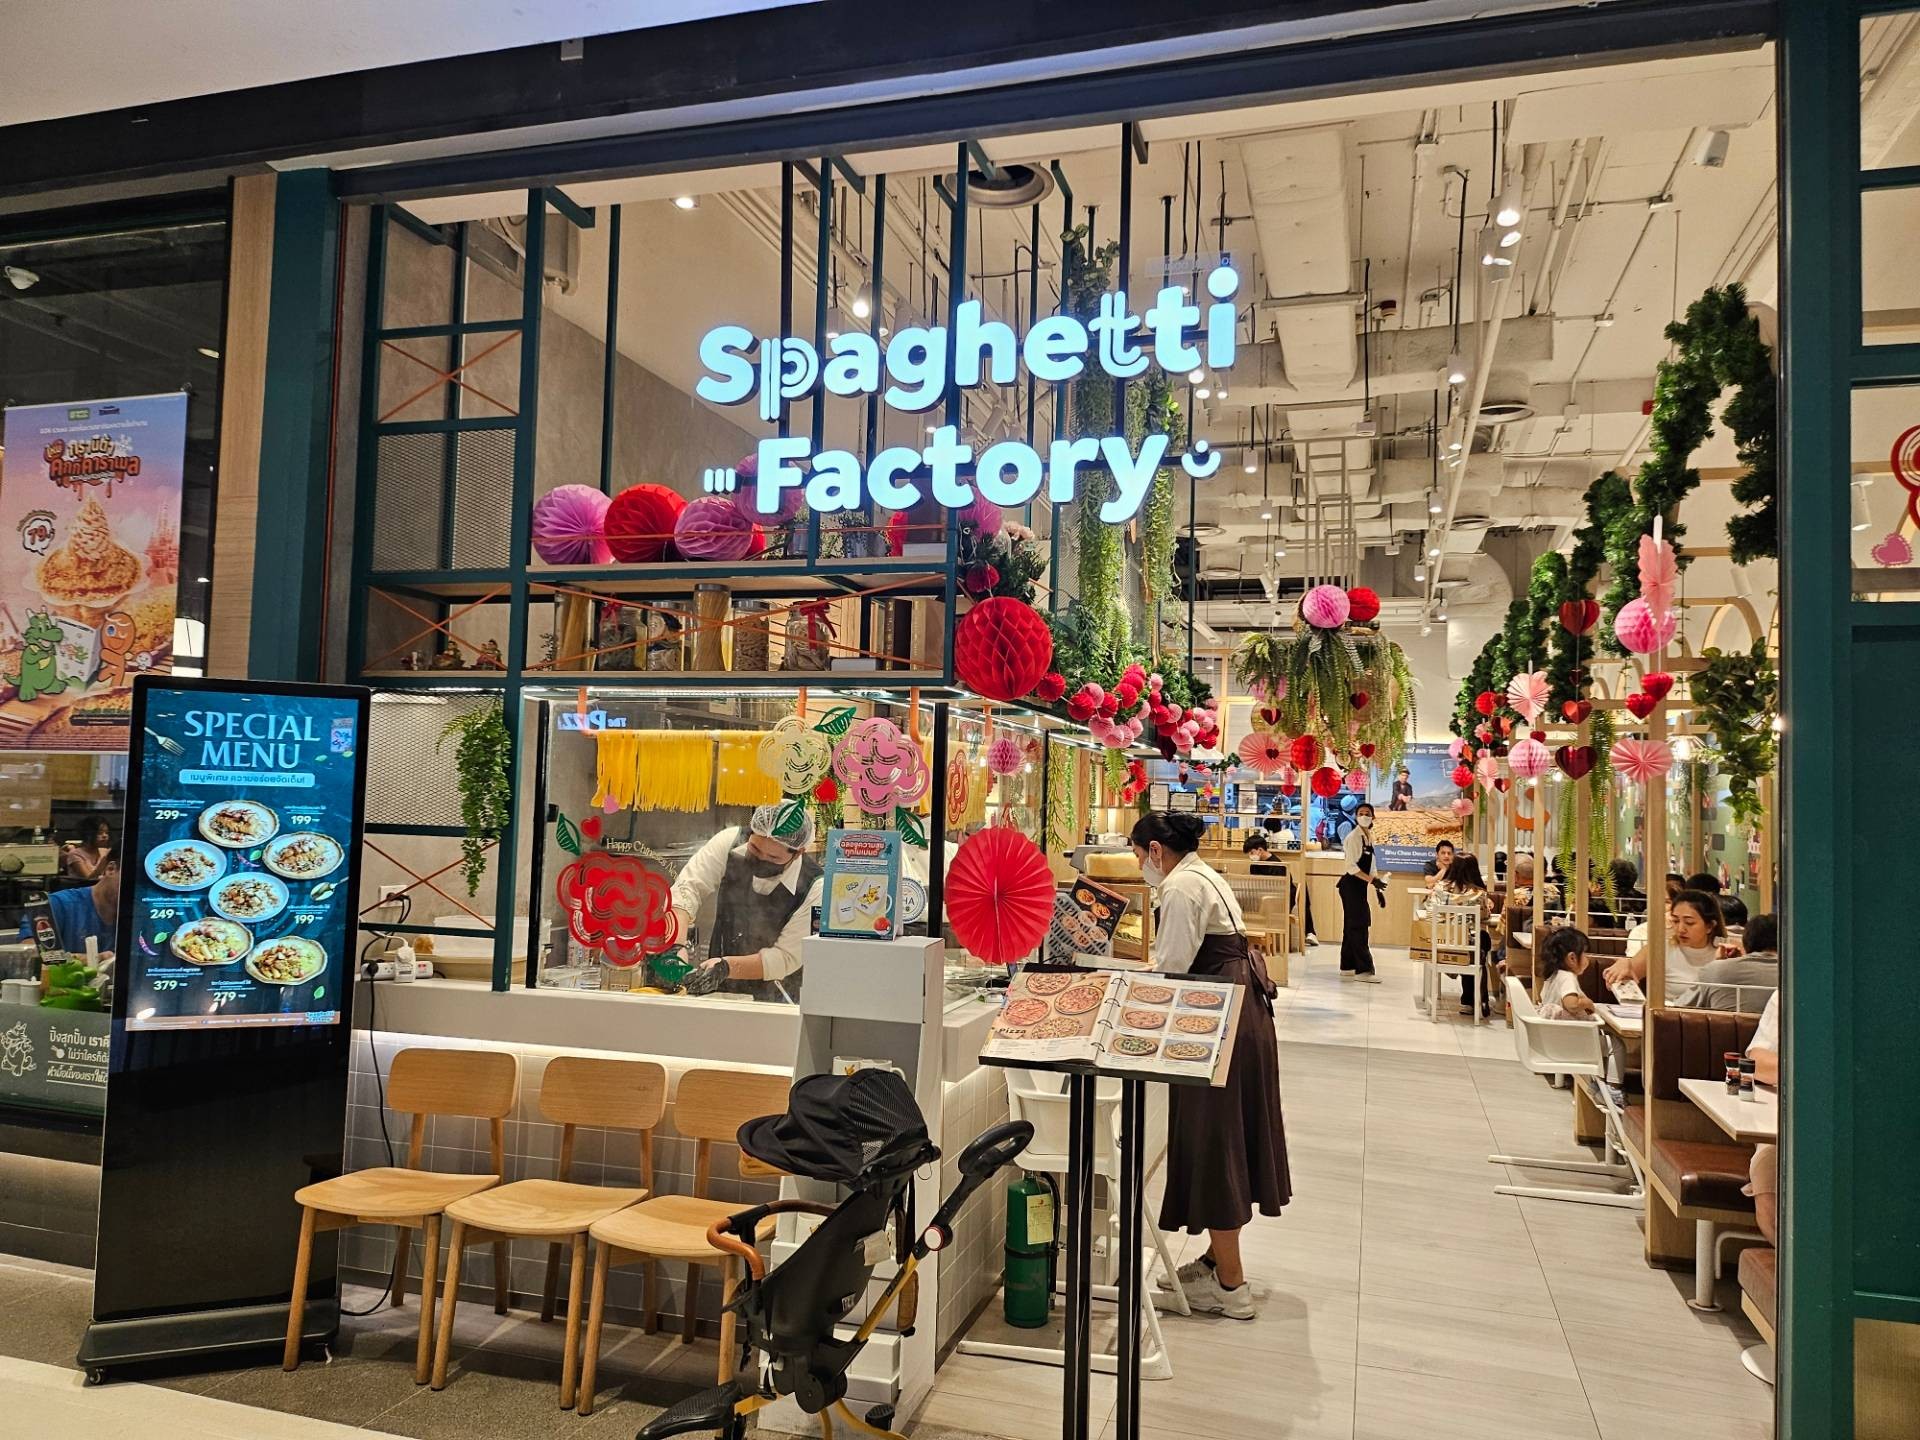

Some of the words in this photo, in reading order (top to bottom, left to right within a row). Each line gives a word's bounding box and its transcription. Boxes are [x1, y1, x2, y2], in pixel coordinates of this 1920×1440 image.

[696, 266, 1237, 421] Spaghetti
[756, 424, 1170, 524] Factory
[184, 710, 320, 741] SPECIAL
[200, 740, 300, 769] MENU
[606, 838, 632, 852] Happy
[68, 1047, 109, 1063] ไม่ว่าใครก็ต้
